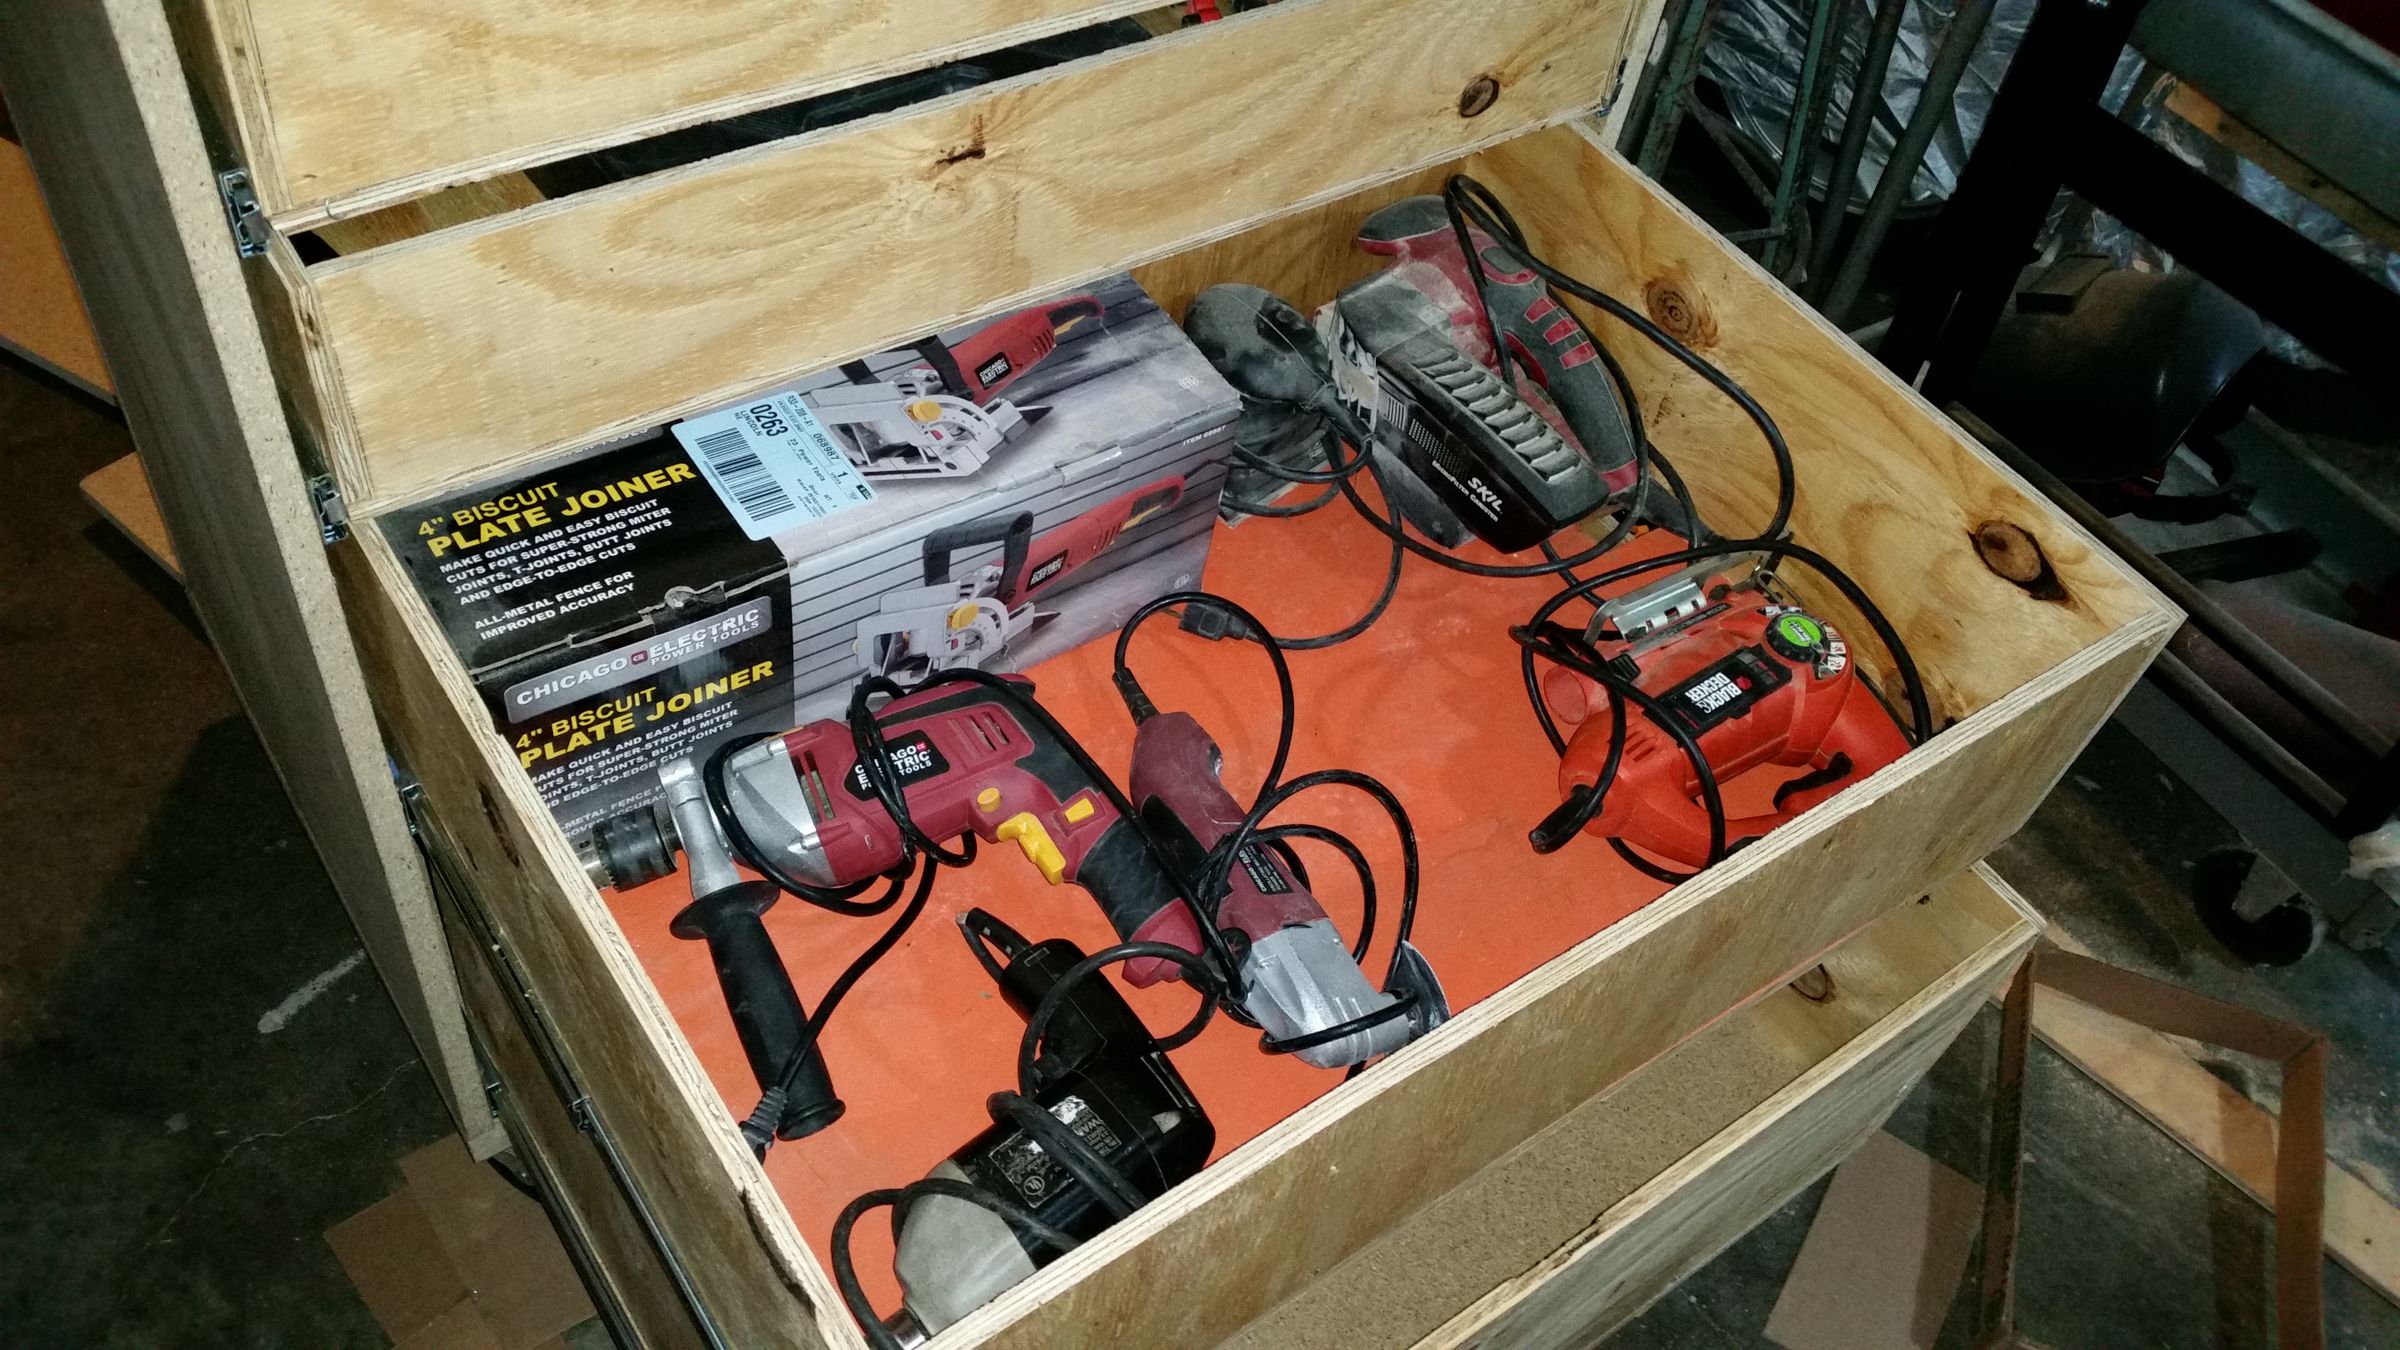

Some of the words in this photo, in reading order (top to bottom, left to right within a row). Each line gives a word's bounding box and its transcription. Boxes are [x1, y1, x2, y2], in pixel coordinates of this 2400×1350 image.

[740, 410, 763, 436] LINCOLN
[750, 404, 788, 437] 0263
[813, 433, 840, 460] 068987
[1183, 434, 1202, 446] ITEM
[790, 438, 799, 446] 23
[798, 448, 813, 467] Power
[812, 466, 825, 482] Tools
[418, 517, 444, 536] 4"
[452, 482, 558, 527] BISCUIT
[426, 506, 552, 557] PLATE
[561, 462, 697, 516] JOINER
[1467, 477, 1502, 512] SKIL
[439, 553, 482, 574] MAKE
[485, 539, 531, 559] QUICK
[535, 529, 563, 545] AND
[567, 515, 600, 534] EASY
[605, 499, 658, 520] BISCUIT
[446, 565, 486, 584] CUTS
[488, 555, 518, 570] FOR
[521, 521, 626, 560] SUPER-STRONG
[629, 507, 671, 526] MITER
[453, 571, 511, 595] JOINTS,
[515, 549, 581, 575] T-JOINTS,
[585, 535, 619, 552] BUTT
[623, 519, 672, 540] JOINTS
[459, 588, 490, 605] AND
[493, 555, 596, 595] EDGE-TO-EDGE
[598, 542, 636, 560] CUTS
[474, 600, 554, 629] ALL-METAL
[556, 582, 602, 602] FENCE
[604, 571, 635, 586] FOR
[480, 610, 556, 640] IMPROVED
[559, 583, 635, 613] ACCURACY
[516, 656, 628, 705] CHICAGO
[649, 608, 760, 657] ELECTRIC
[650, 641, 705, 666] POWER
[710, 620, 760, 643] TOOLS
[520, 713, 636, 769] PLATE
[646, 660, 775, 722] JOINER
[1684, 672, 1731, 702] DECKER
[515, 728, 542, 749] 4"
[551, 687, 657, 737] BISCUIT
[568, 750, 611, 769] QUICK
[615, 736, 642, 752] AND
[645, 723, 678, 740] EASY
[682, 701, 734, 725] BISCUIT
[537, 776, 565, 792] UTS
[567, 765, 595, 780] FOR
[597, 725, 697, 768] SUPER-STRONG
[699, 709, 739, 728] MITER
[540, 781, 583, 802] OINTS,
[585, 755, 648, 782] T-JOINTS,
[651, 740, 686, 758] BUTT
[688, 720, 734, 743] JOINTS
[563, 760, 657, 802] EDGE-TO-EDGE
[660, 746, 694, 764] CUTS
[898, 759, 932, 776] TOOLS
[608, 792, 668, 819] ACCURAC
[610, 789, 652, 810] FENCE
[1248, 867, 1267, 892] CHICAGO
